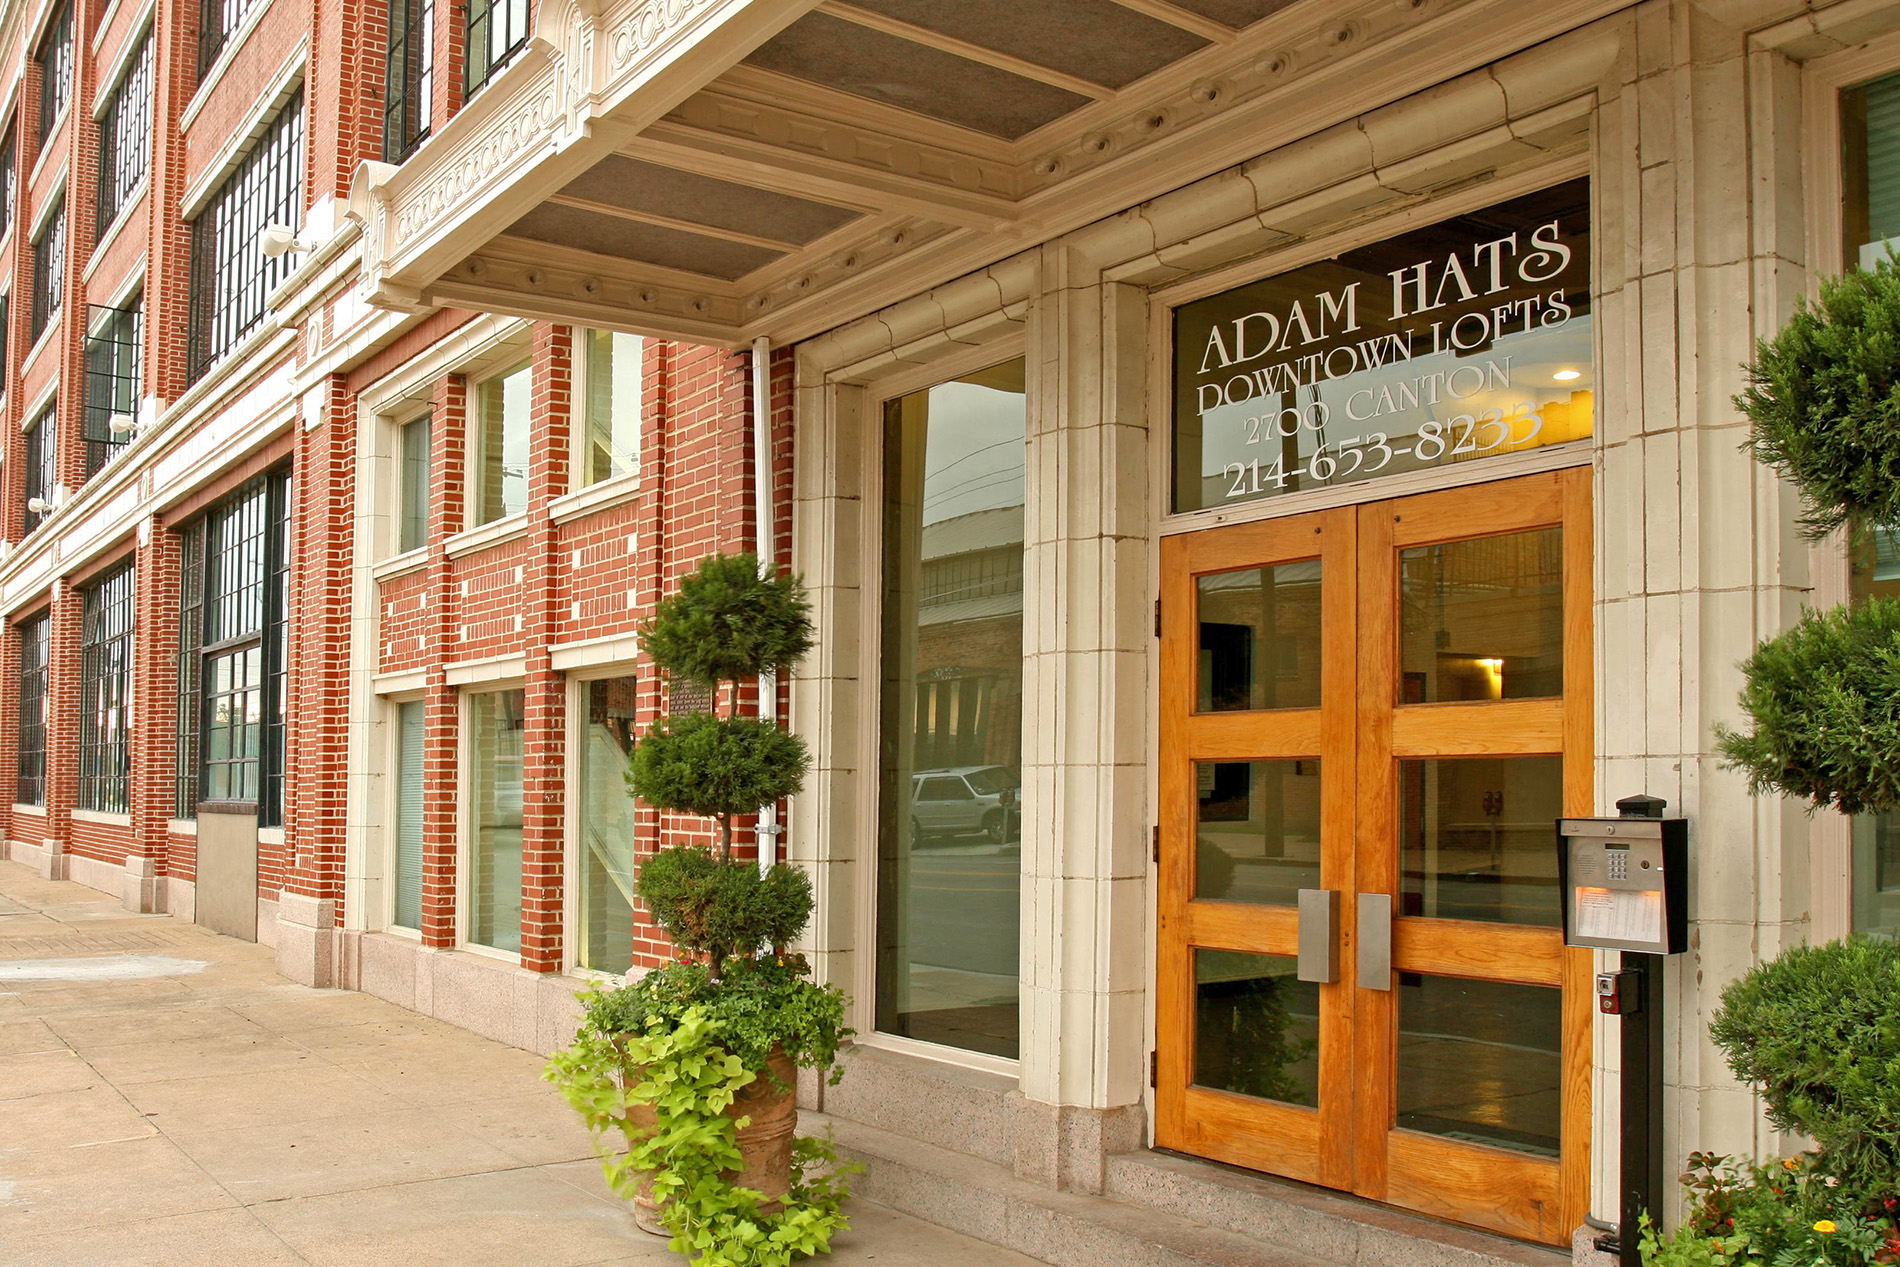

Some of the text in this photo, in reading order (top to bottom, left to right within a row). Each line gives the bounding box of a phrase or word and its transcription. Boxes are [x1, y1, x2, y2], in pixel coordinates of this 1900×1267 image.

[1197, 220, 1571, 374] ADAM HATS
[1197, 288, 1571, 416] DOWNTOWN LOFTS
[1223, 400, 1544, 498] 214-653-8233
[1243, 356, 1513, 446] 2700 CANTON
